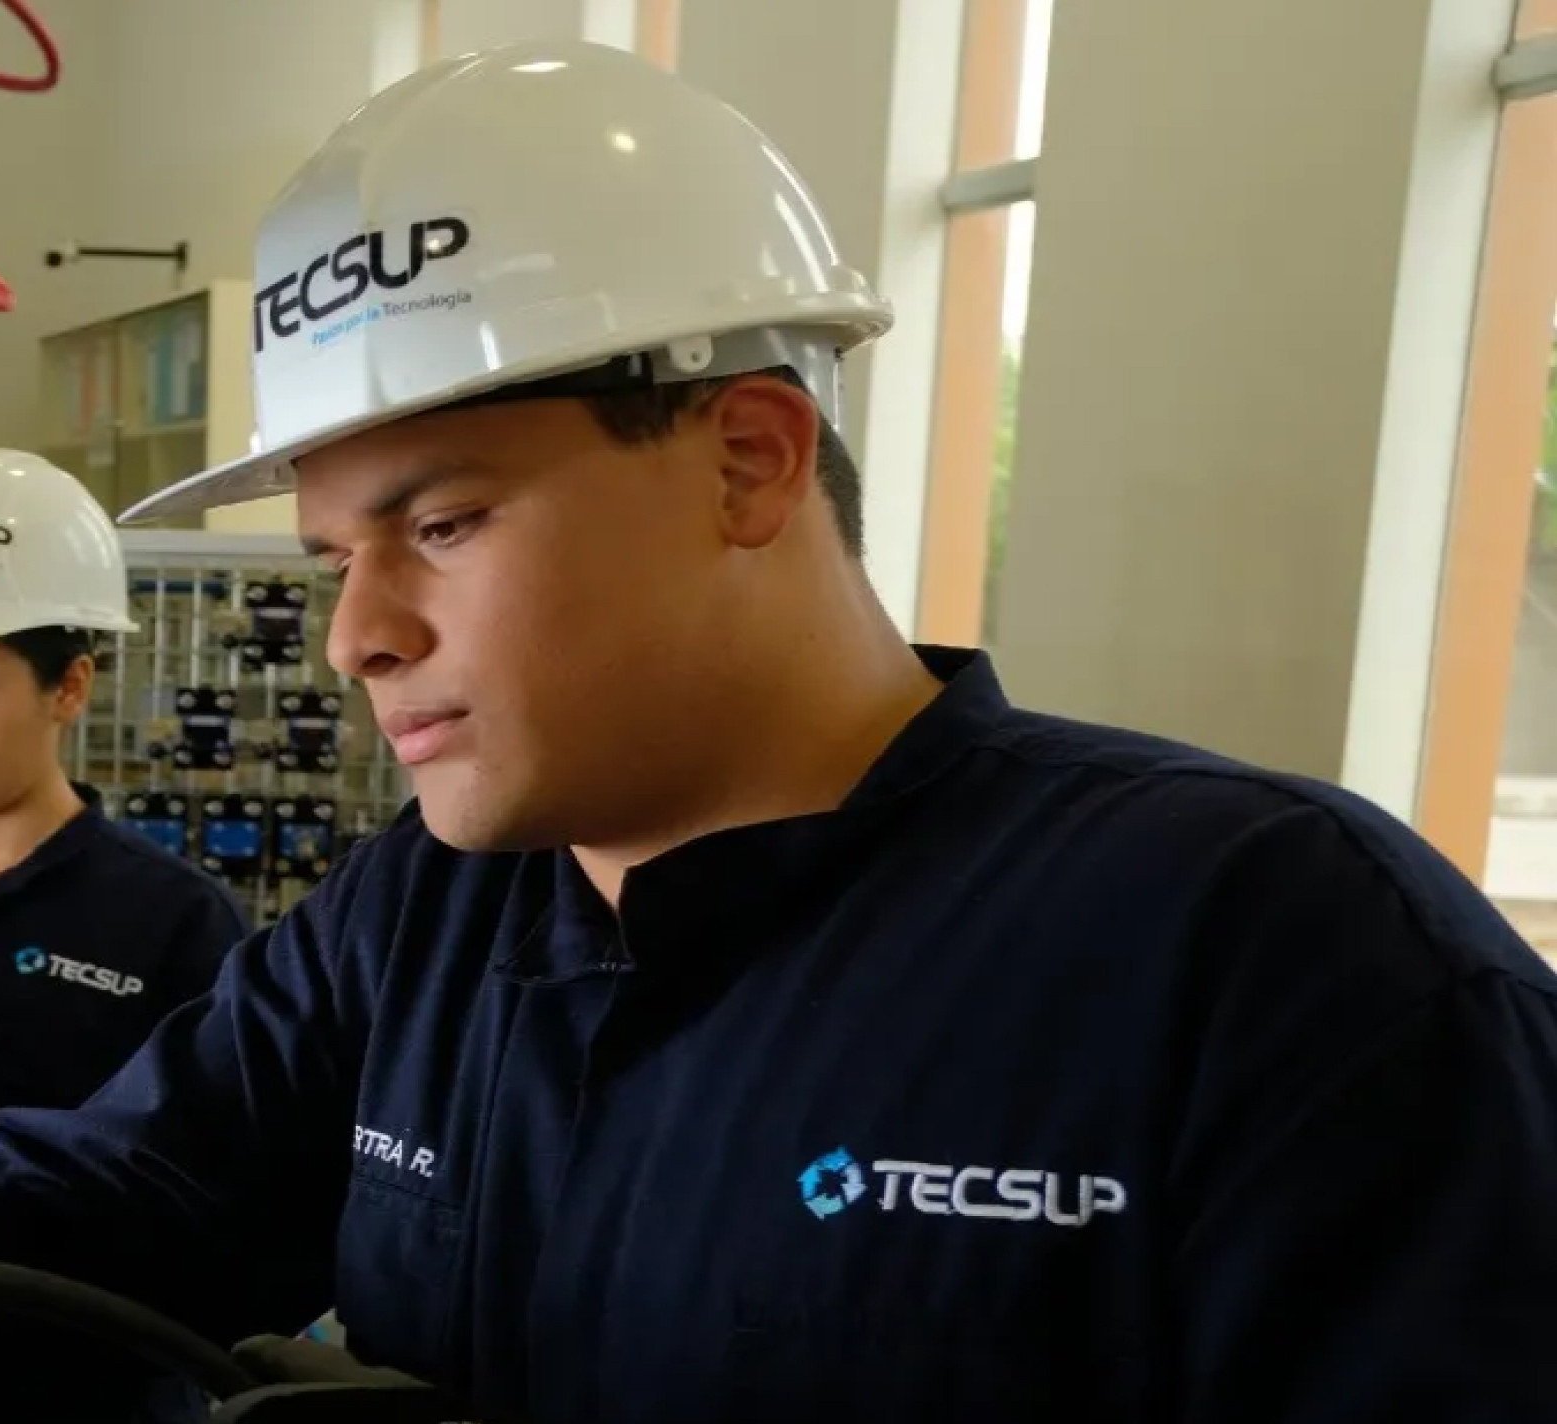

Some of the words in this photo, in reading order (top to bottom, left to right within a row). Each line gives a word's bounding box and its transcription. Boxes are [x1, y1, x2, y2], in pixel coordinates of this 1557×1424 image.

[254, 216, 470, 352] TECSUP
[49, 953, 143, 996] TECSUP
[872, 1159, 1128, 1228] TECSUP
